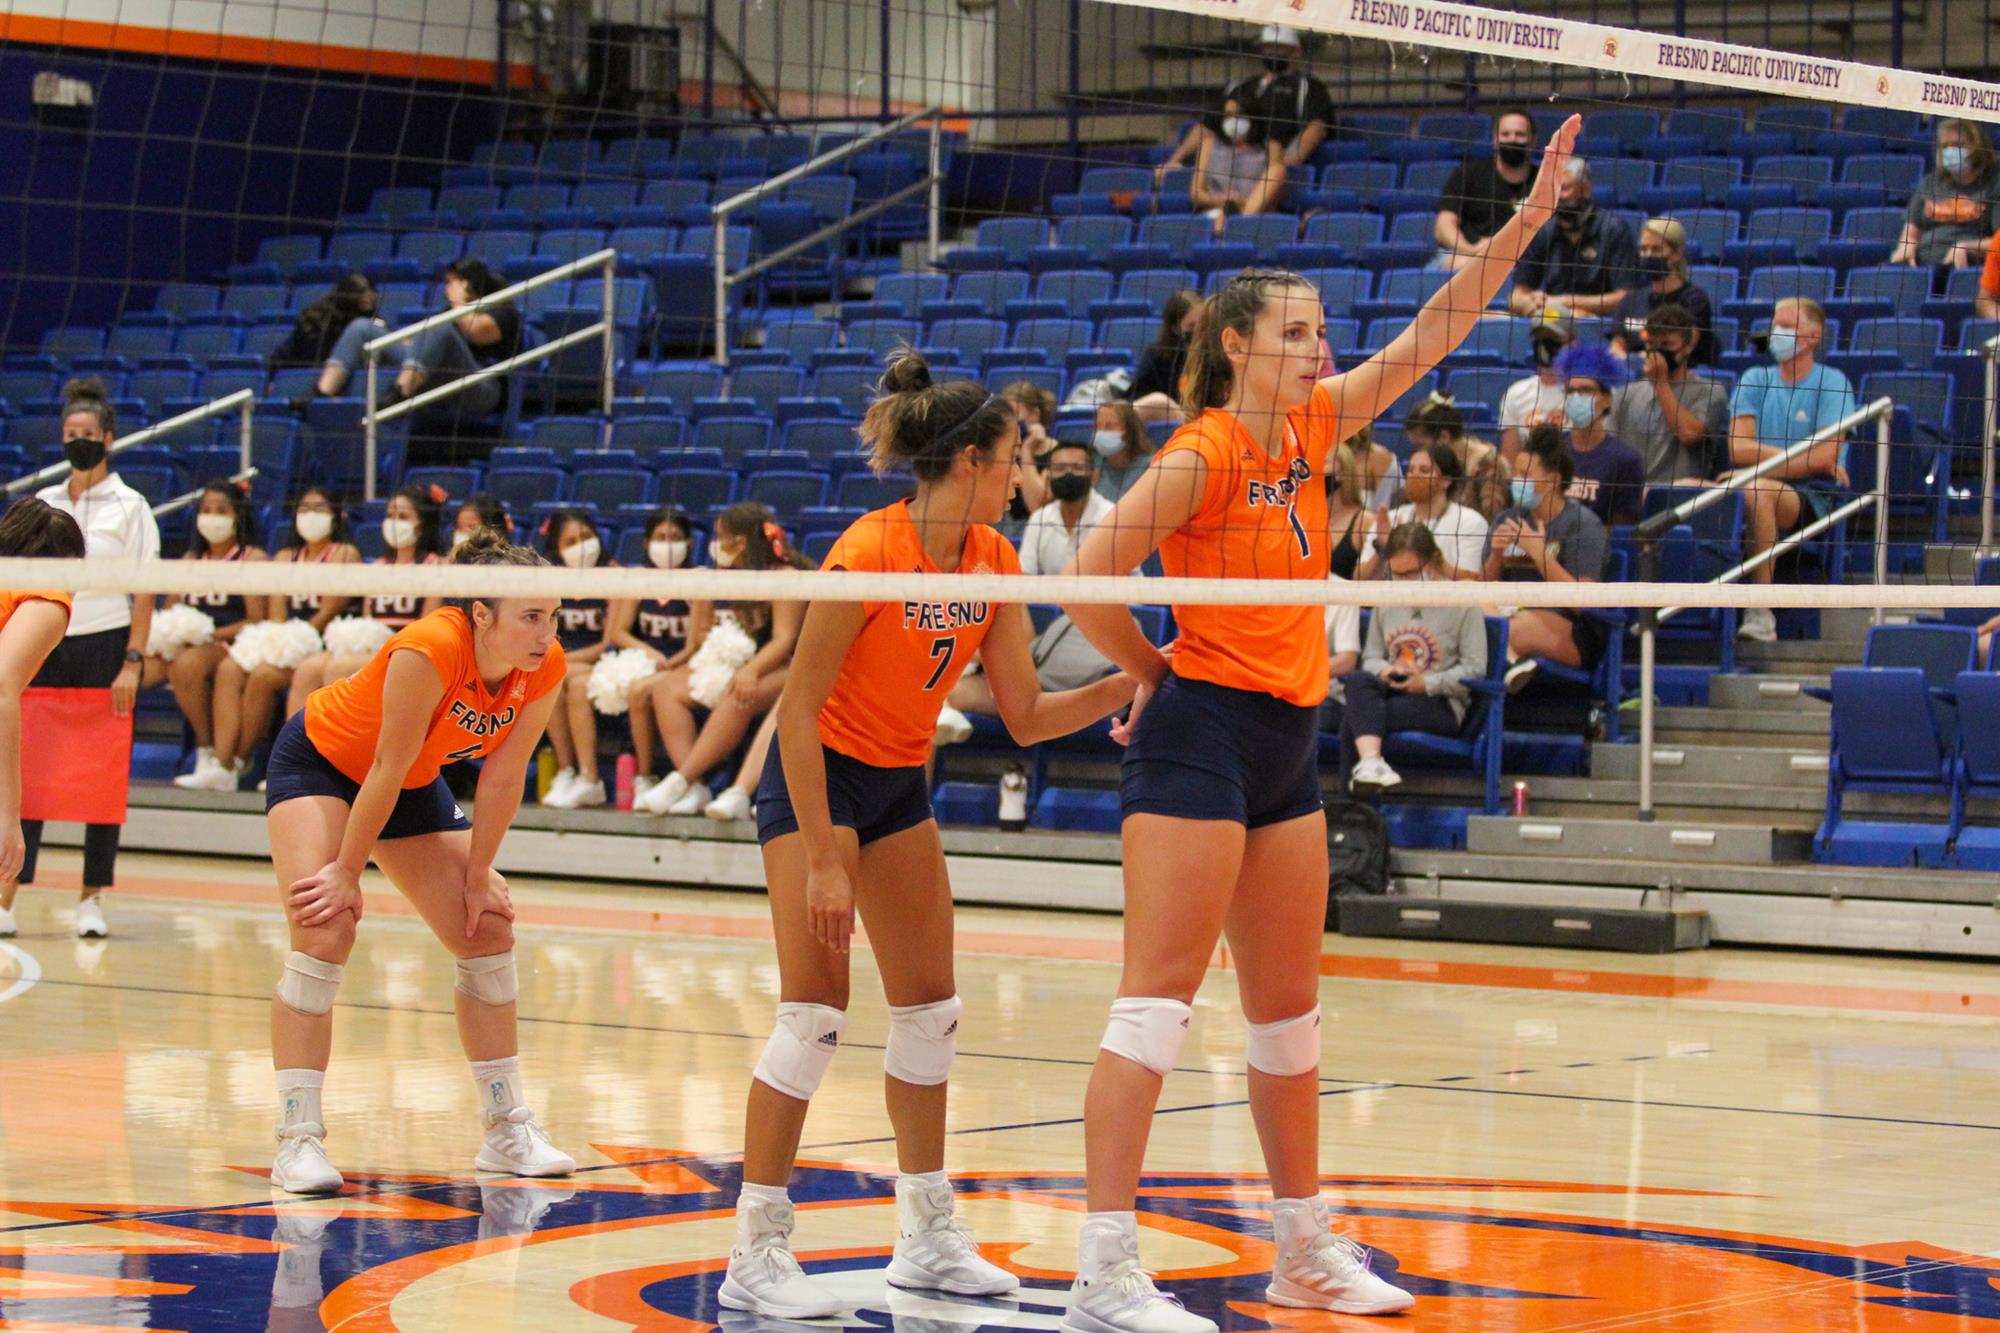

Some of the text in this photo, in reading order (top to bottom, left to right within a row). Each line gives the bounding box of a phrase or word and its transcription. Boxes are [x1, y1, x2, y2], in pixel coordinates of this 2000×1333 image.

[1351, 0, 1563, 51] FRESNO PACIFIC UNIVERSITY
[1658, 43, 1842, 88] FRESNO PACIFIC UNIVERSITY
[1922, 81, 1968, 106] FRESNO
[1288, 502, 1311, 559] 1
[180, 592, 228, 607] PU
[368, 594, 416, 613] PU
[904, 601, 988, 631] FRESNO
[922, 634, 957, 692] 7
